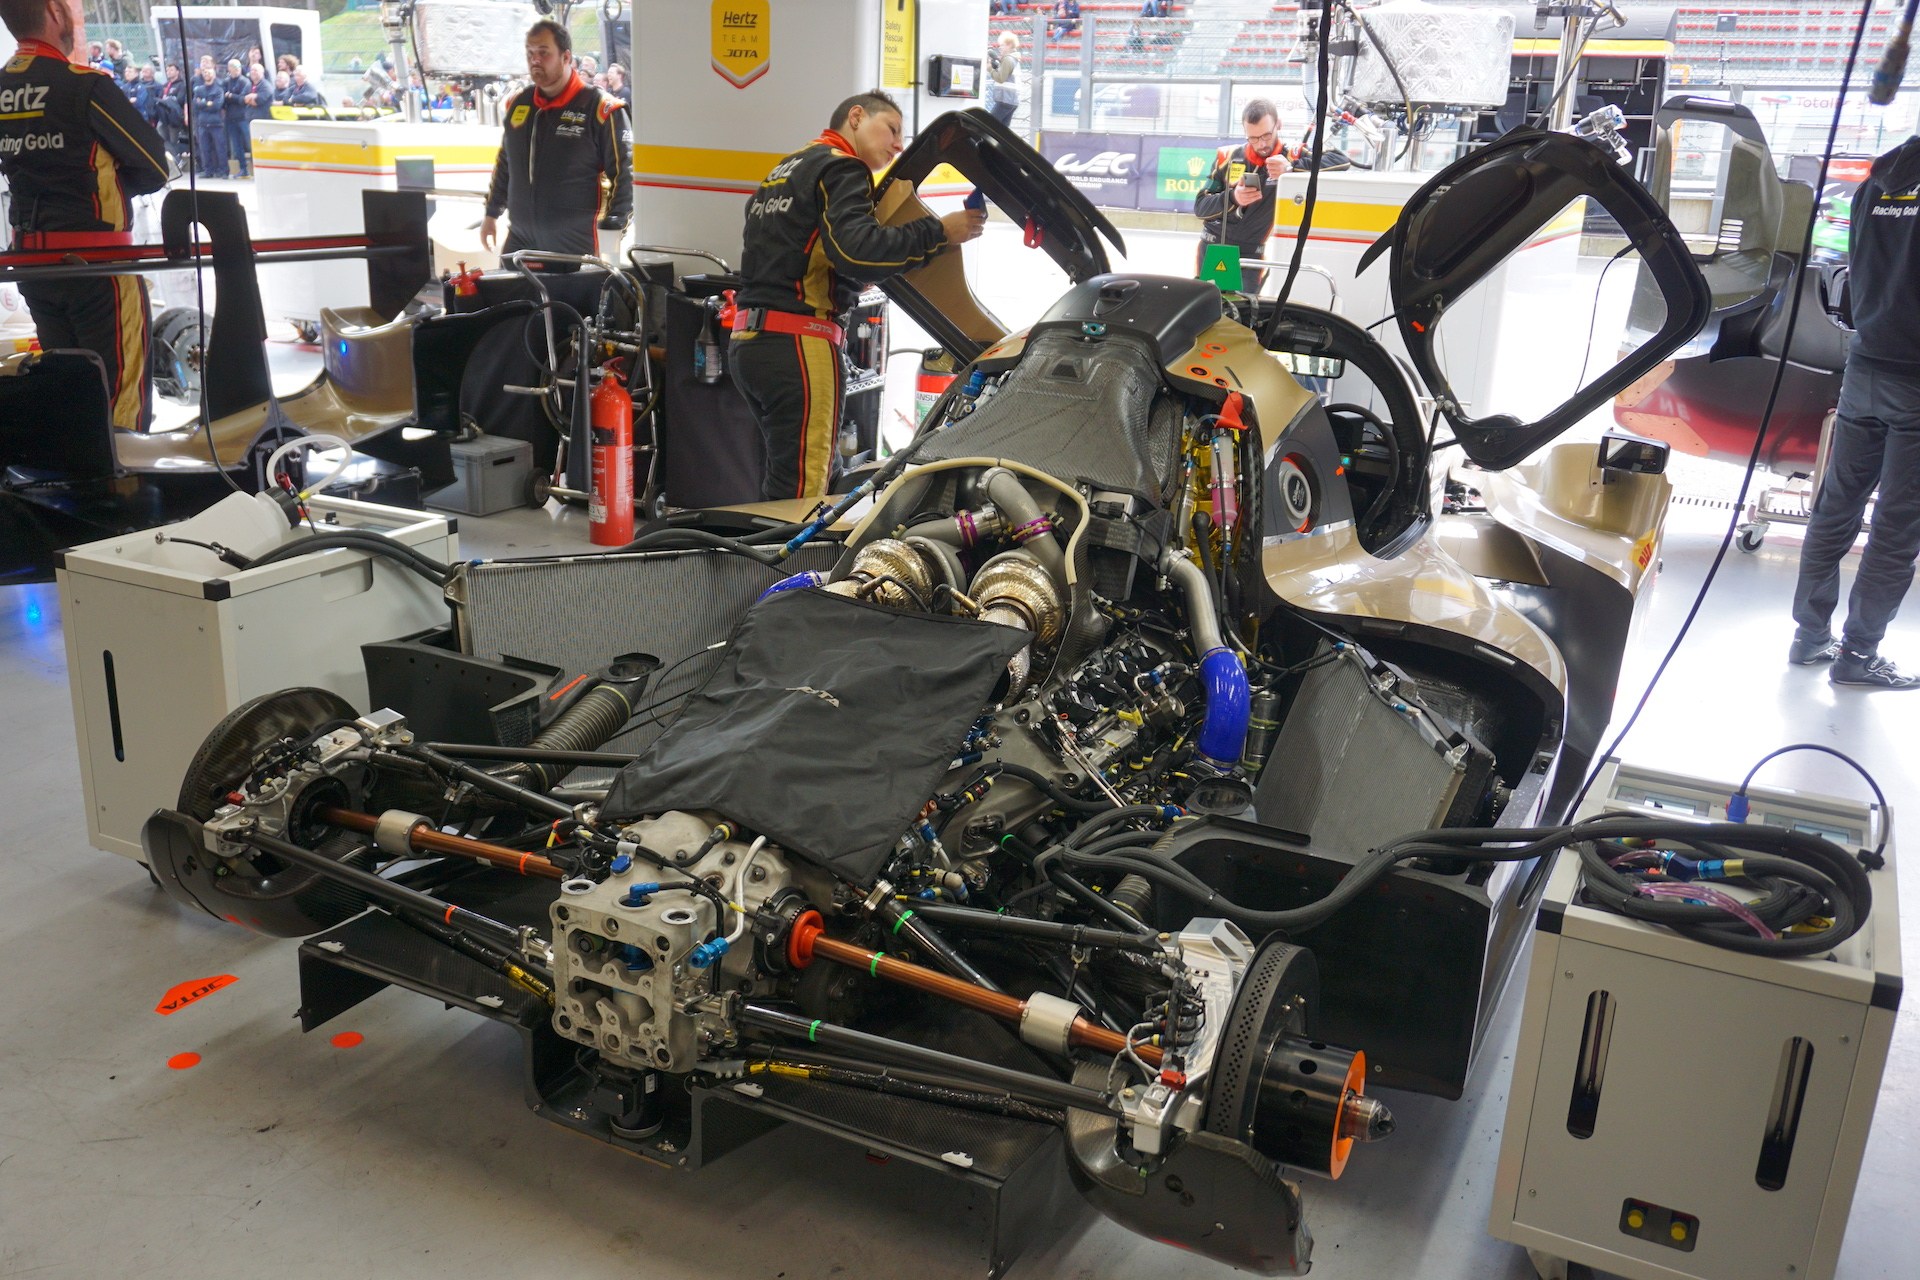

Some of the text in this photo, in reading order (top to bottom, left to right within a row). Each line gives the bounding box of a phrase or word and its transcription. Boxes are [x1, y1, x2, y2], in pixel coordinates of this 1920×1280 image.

[722, 11, 758, 25] Hertz
[884, 20, 901, 32] Safety
[722, 34, 758, 43] TEAM
[884, 32, 904, 43] Rescue
[722, 49, 758, 58] JOTA
[884, 45, 898, 54] Hook
[0, 83, 50, 112] ertz
[0, 132, 65, 156] cing Gold
[1053, 151, 1136, 176] WEC
[1089, 176, 1128, 184] ENDURANCE
[1165, 178, 1206, 193] ROL
[765, 195, 794, 214] Gold
[1871, 205, 1903, 218] Racing
[161, 977, 224, 1010] JOTA
